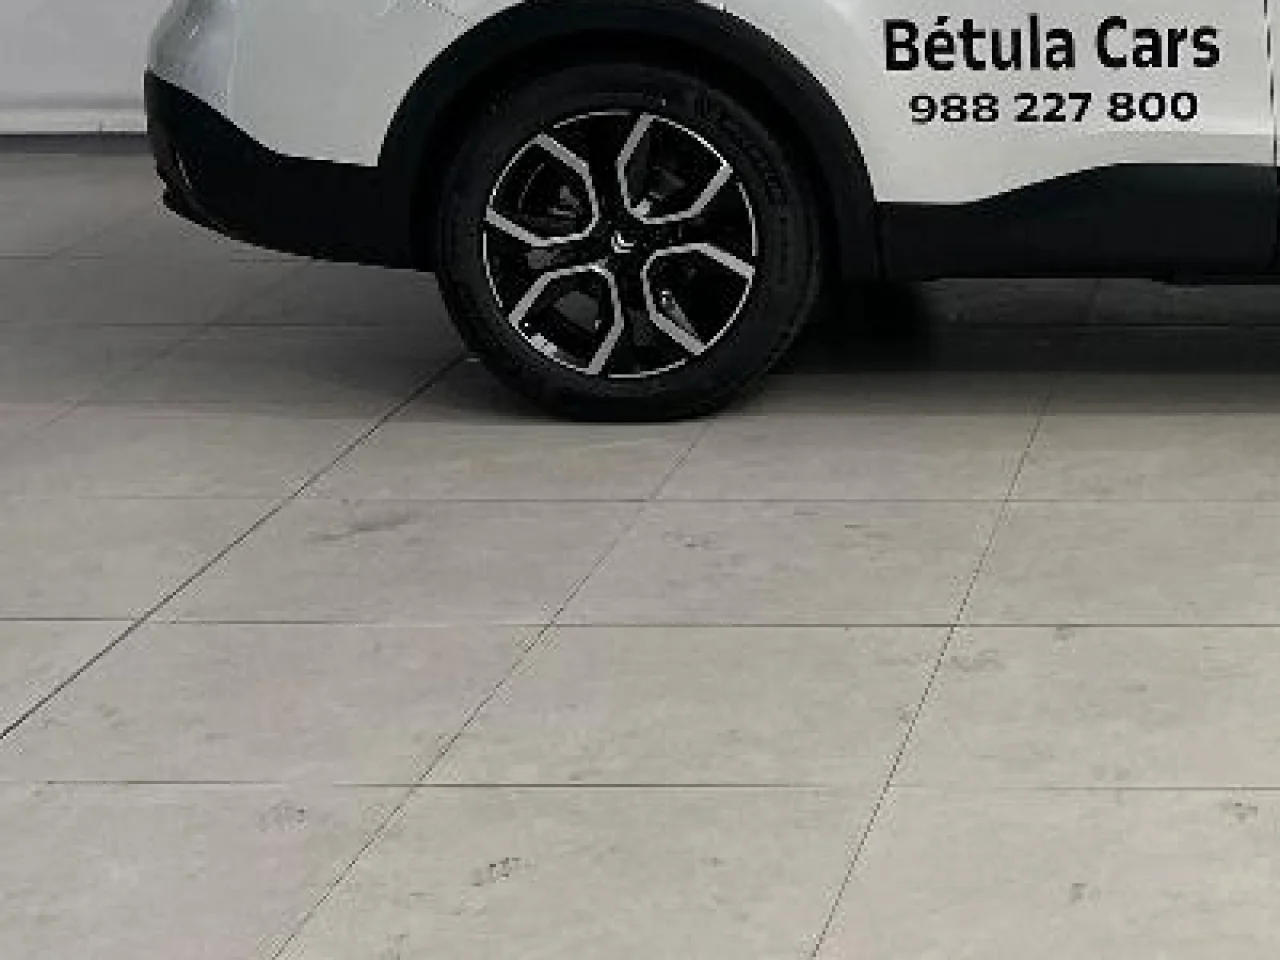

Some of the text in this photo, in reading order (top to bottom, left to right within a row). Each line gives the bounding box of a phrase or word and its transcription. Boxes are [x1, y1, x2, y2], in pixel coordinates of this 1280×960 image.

[885, 12, 1220, 71] Bétula Cars
[909, 92, 1198, 125] 988 227 800
